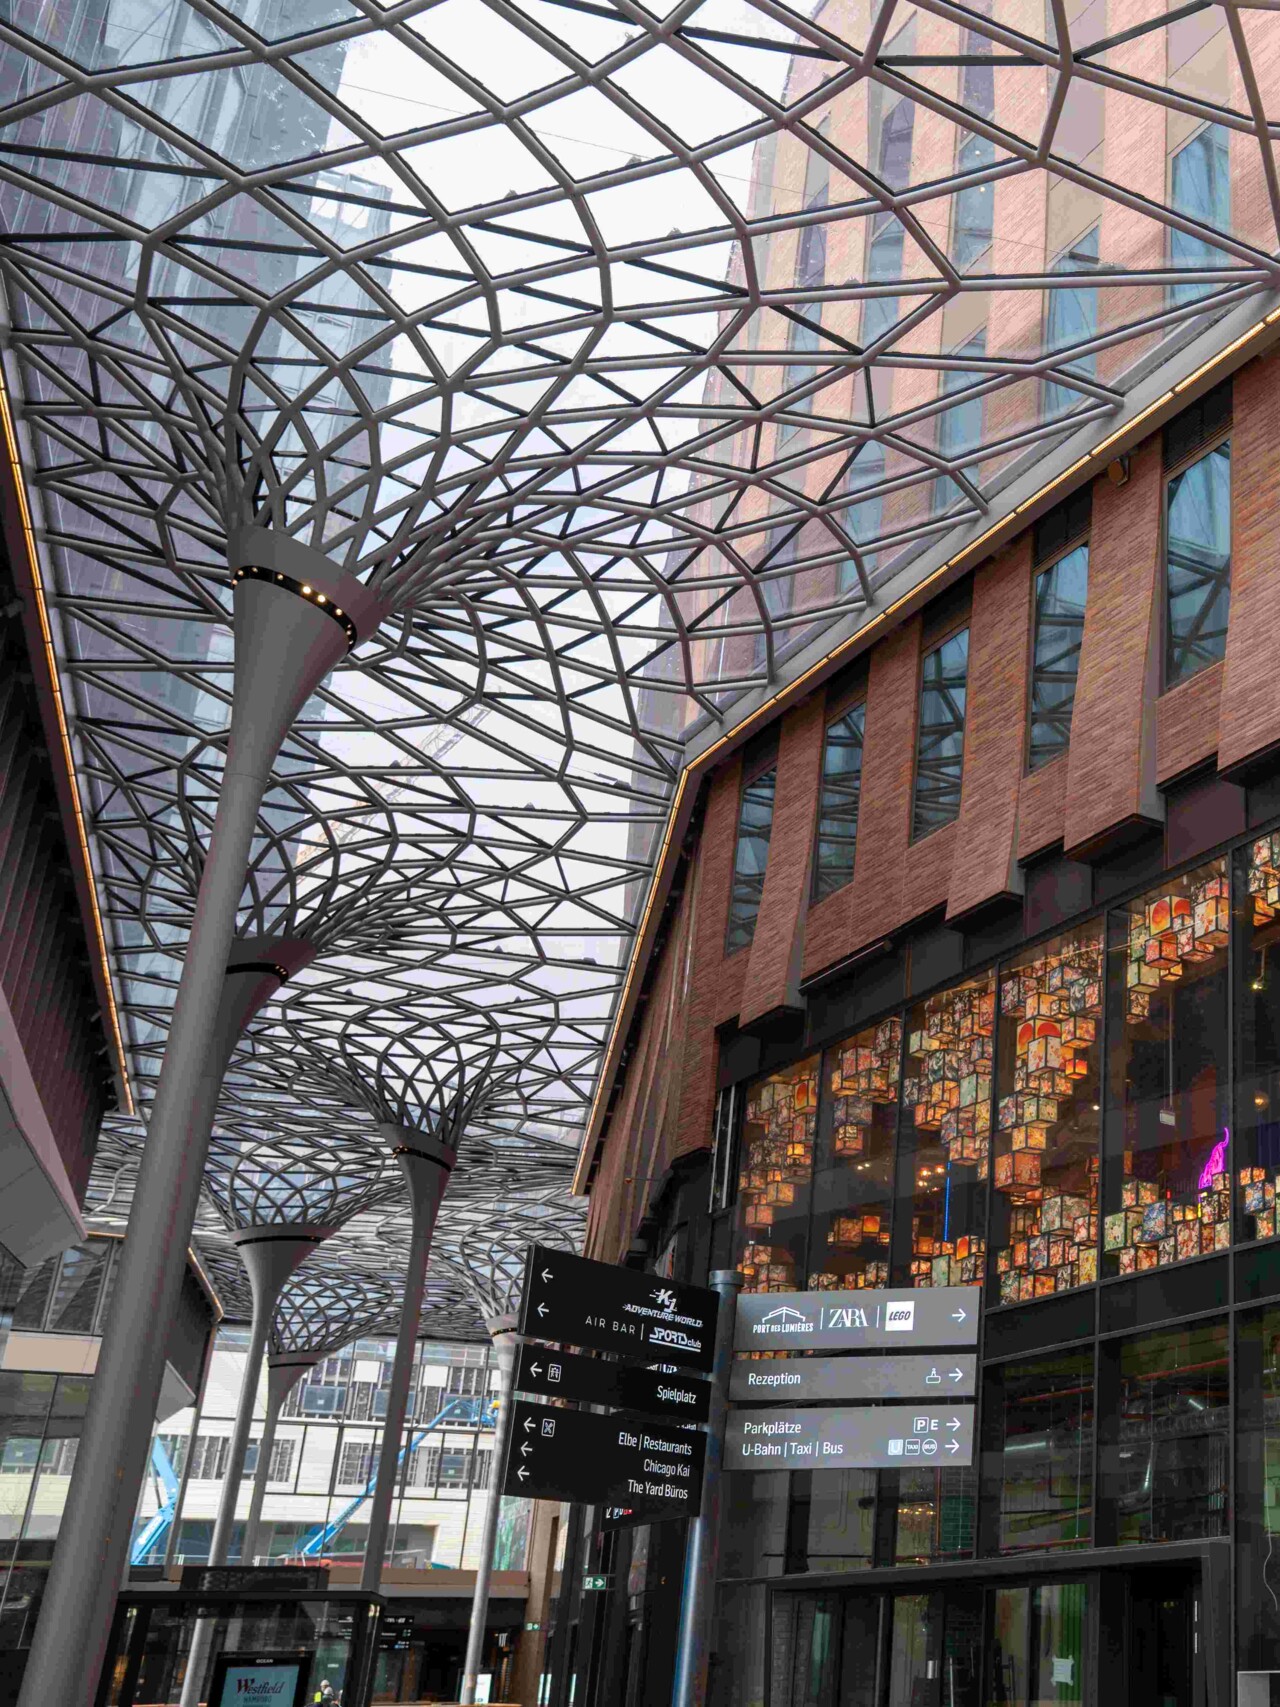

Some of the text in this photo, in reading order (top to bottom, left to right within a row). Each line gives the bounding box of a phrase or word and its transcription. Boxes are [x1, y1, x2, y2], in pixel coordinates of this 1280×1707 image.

[585, 1315, 636, 1335] AIR BAR
[624, 1303, 703, 1328] ADVENTURE WORLD
[828, 1308, 869, 1328] ZARA
[888, 1310, 911, 1321] LEGO
[649, 1326, 702, 1348] SPORTS club
[753, 1324, 770, 1334] PORT
[781, 1321, 814, 1333] LUMIÈRES
[748, 1373, 801, 1387] Rezeption
[656, 1385, 697, 1404] Spielplatz
[744, 1421, 802, 1436] Parkplätze
[930, 1419, 939, 1430] E
[618, 1431, 692, 1455] Elbe Restaurants
[742, 1441, 844, 1456] U-Bahn Taxi Bus
[643, 1458, 691, 1477] Chicago Kai
[628, 1479, 688, 1499] The Yard Büros
[236, 1678, 286, 1695] Westfield
